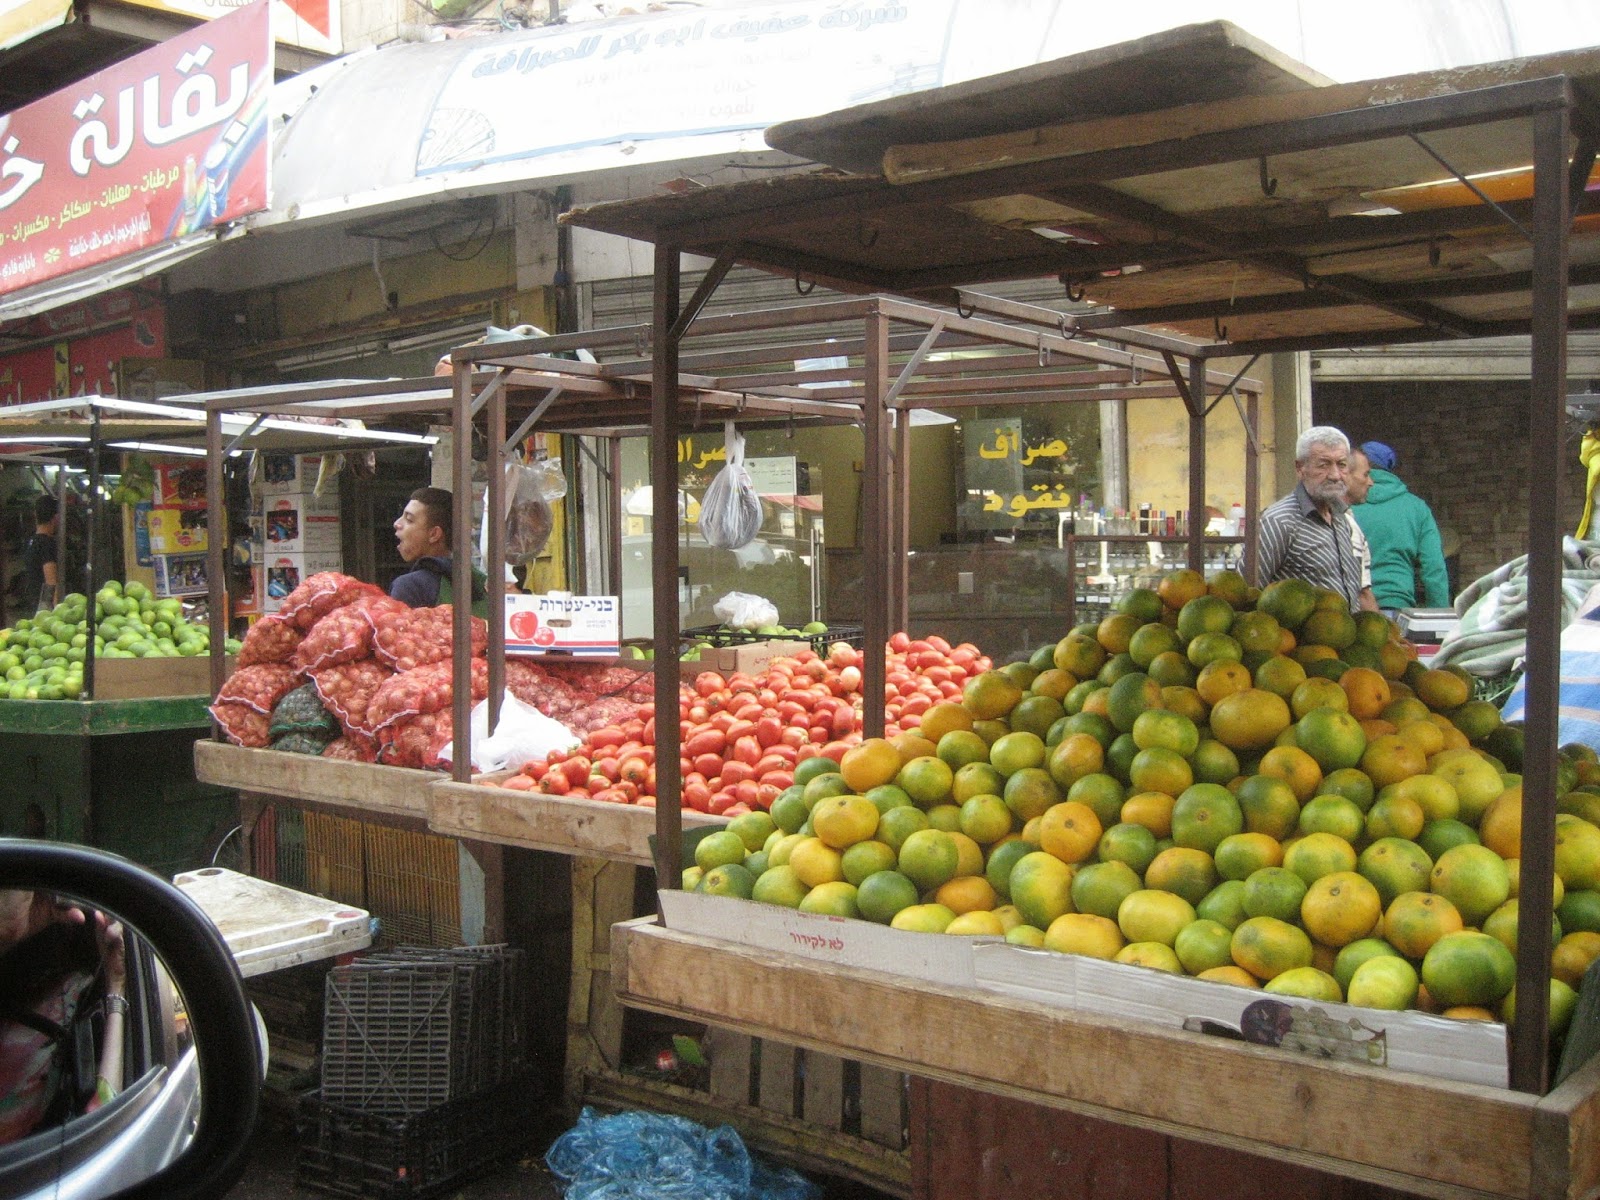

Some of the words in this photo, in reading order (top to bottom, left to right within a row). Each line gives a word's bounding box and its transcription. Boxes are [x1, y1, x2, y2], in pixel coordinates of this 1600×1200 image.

[818, 0, 908, 32] شركة
[472, 34, 603, 78] للصرافة
[69, 44, 250, 176] بقالة
[141, 165, 180, 195] مرطبات
[100, 184, 131, 210] معلبات
[12, 215, 50, 242] مكسرات
[58, 200, 92, 229] سكاكر
[980, 428, 1068, 466] صراف
[983, 484, 1071, 517] نقود
[539, 599, 613, 612] בני-עטרות
